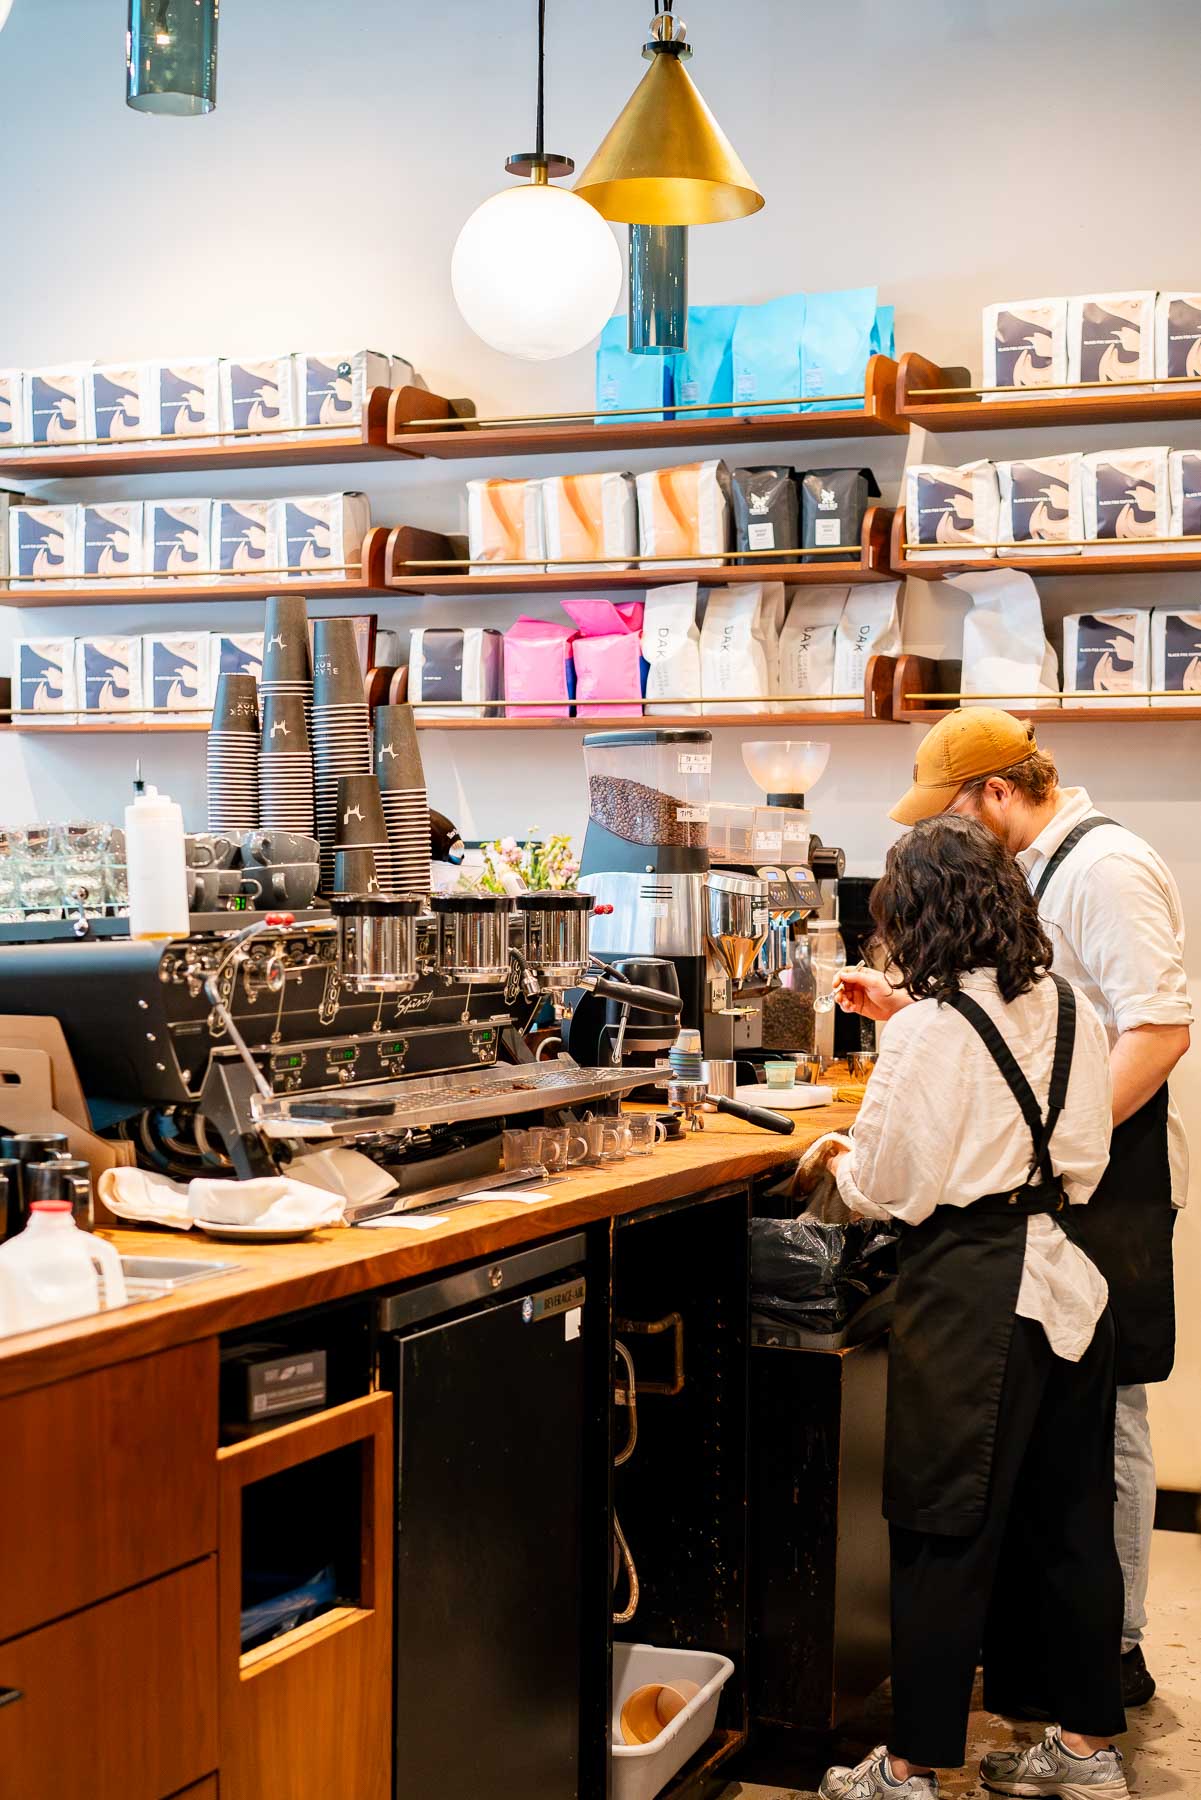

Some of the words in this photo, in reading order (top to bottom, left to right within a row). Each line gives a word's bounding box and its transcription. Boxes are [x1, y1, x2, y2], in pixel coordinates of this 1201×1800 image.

[656, 628, 669, 658] DAK
[720, 625, 734, 652] DAK
[799, 626, 816, 653] DAK
[854, 625, 870, 652] DAK
[394, 990, 433, 1018] Spirit
[1031, 1756, 1052, 1774] N
[856, 1781, 871, 1798] N
